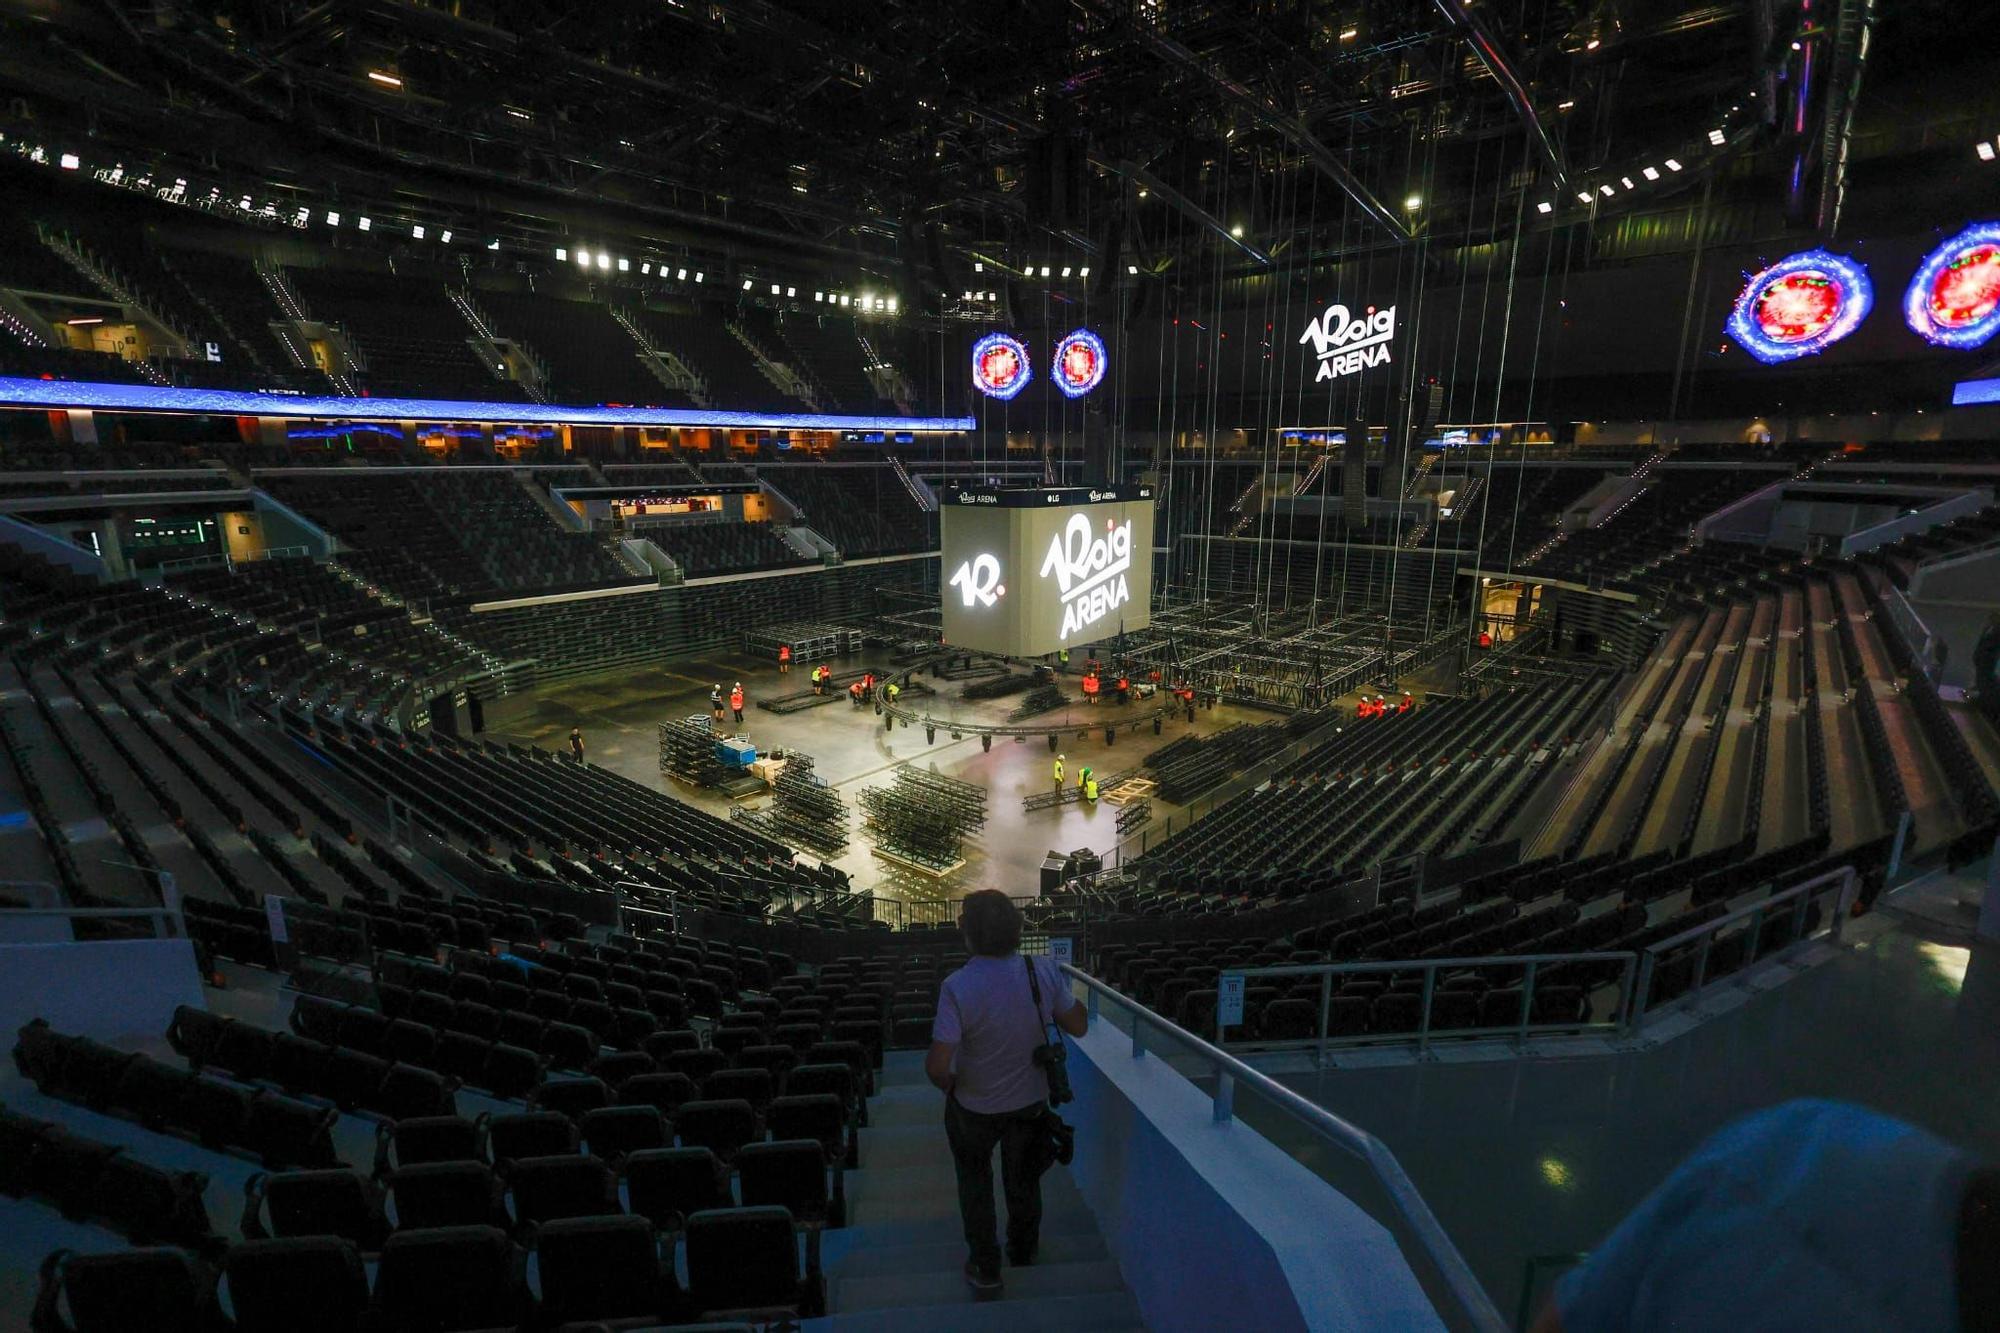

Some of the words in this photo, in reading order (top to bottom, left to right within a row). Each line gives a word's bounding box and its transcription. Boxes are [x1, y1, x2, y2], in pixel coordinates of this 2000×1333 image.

[1299, 304, 1397, 360] Roig
[1315, 342, 1391, 383] ARENA
[977, 493, 997, 504] ARENA
[1039, 512, 1132, 603] Roig
[1060, 574, 1129, 641] ARENA
